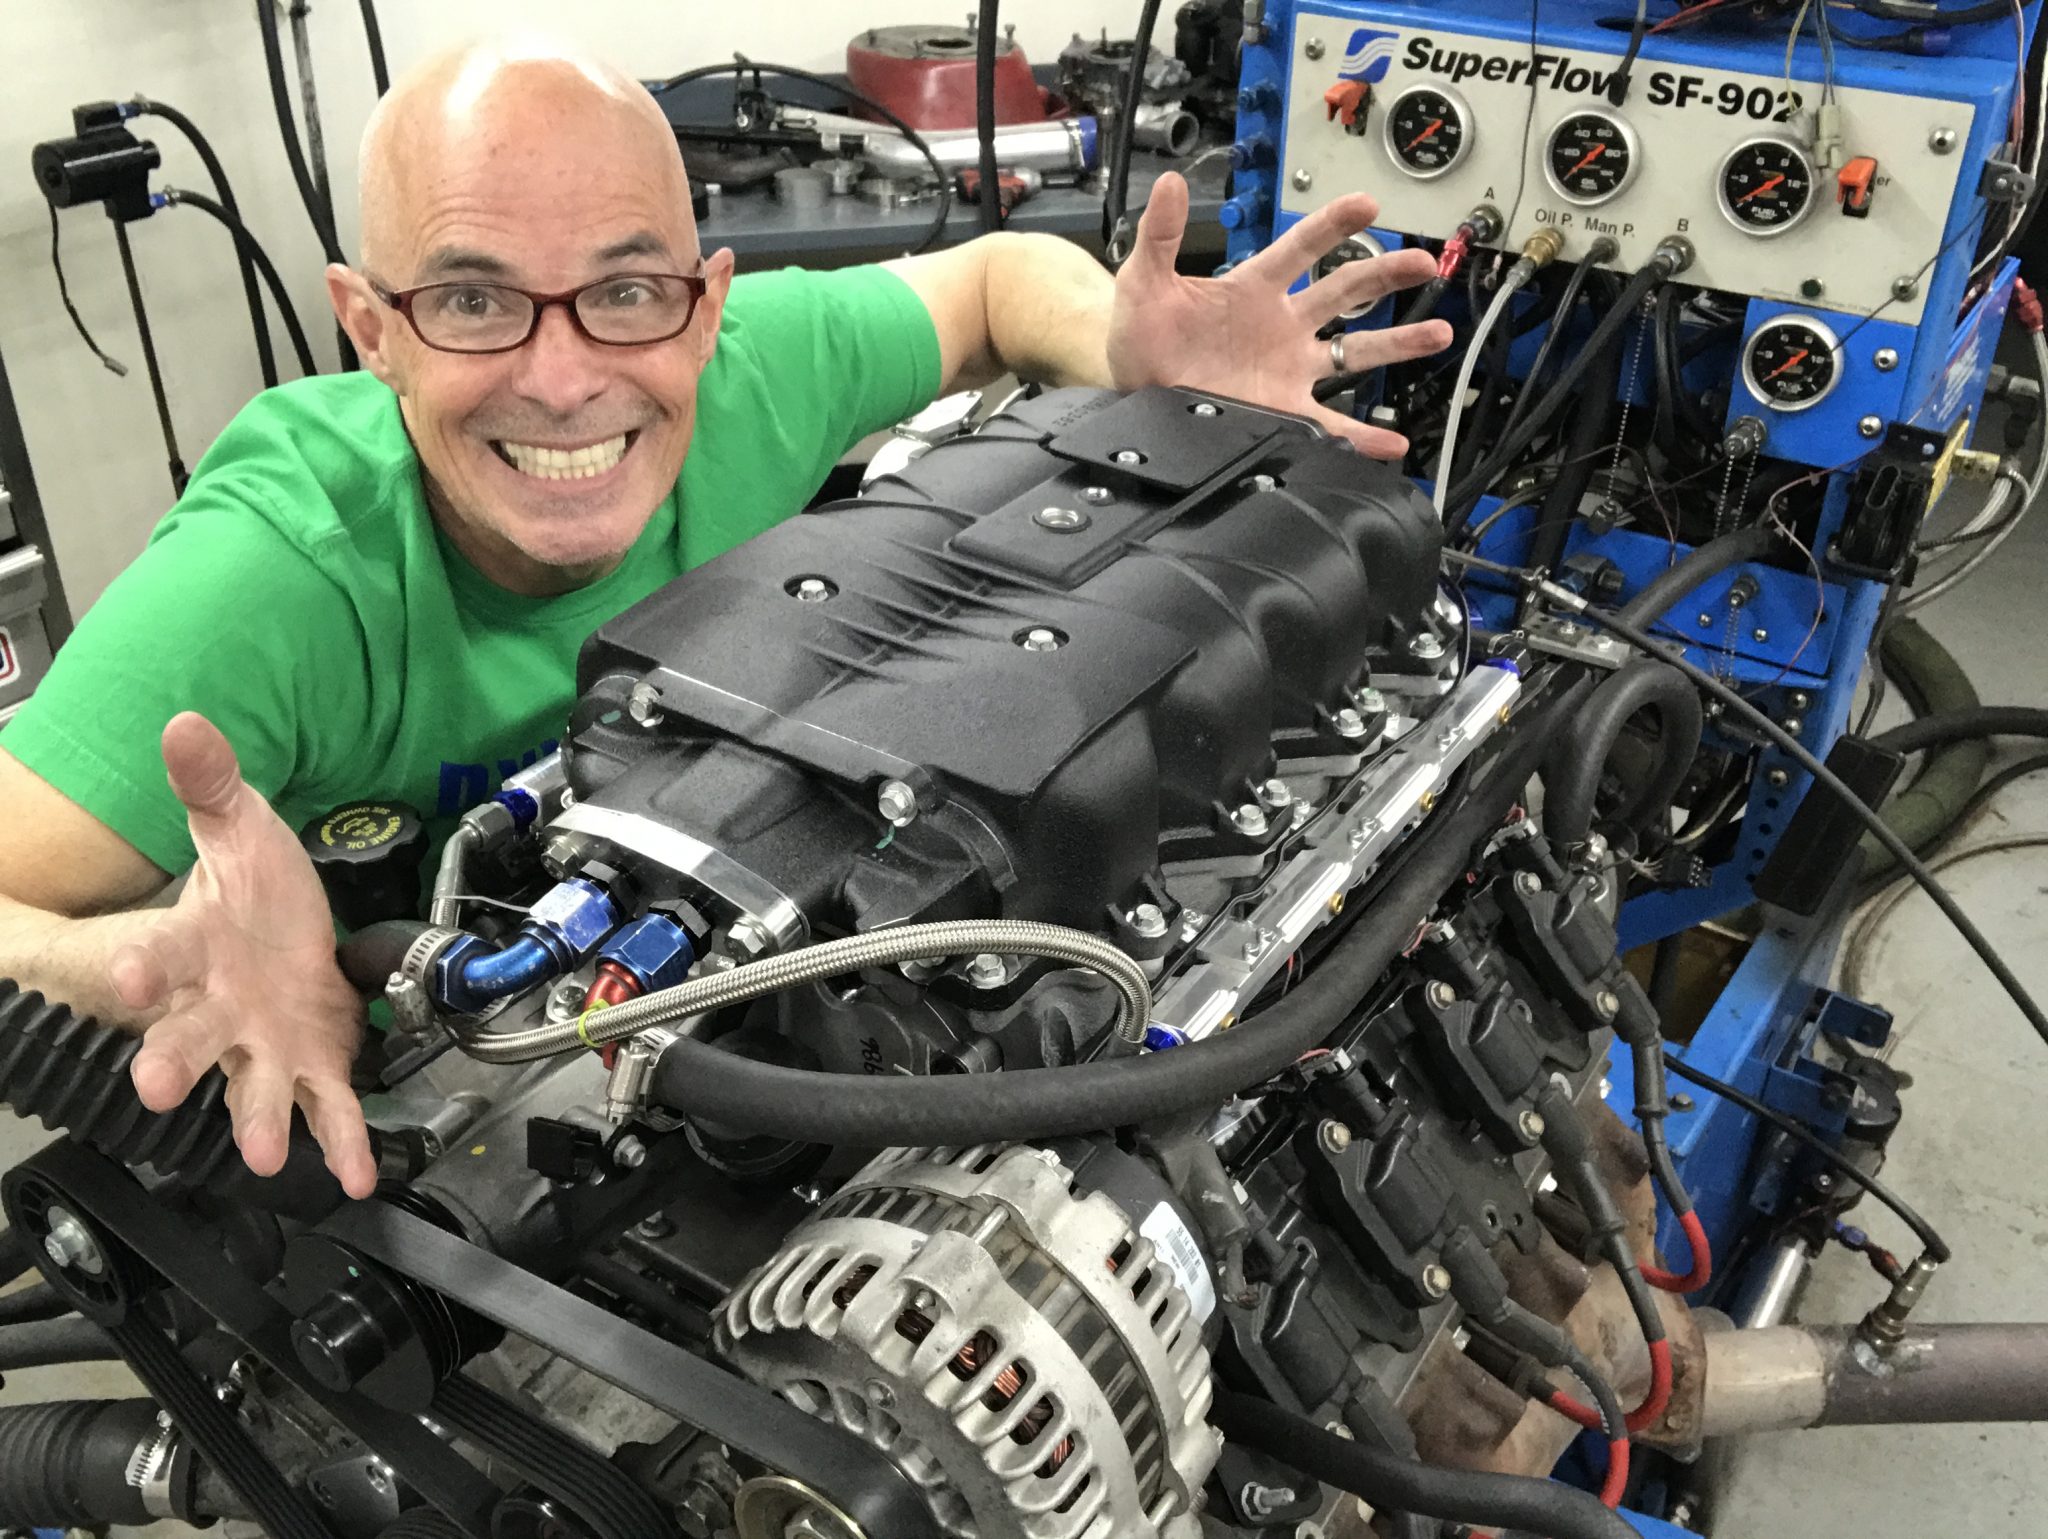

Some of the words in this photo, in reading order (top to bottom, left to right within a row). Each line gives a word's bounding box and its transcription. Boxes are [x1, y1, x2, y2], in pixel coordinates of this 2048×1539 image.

[1647, 72, 1803, 123] SF-902
[1574, 129, 1590, 138] 40
[1564, 148, 1580, 156] 20
[1788, 179, 1802, 189] 12
[1484, 186, 1495, 200] A
[1534, 207, 1557, 225] Oil
[1561, 212, 1574, 228] P.
[1584, 216, 1618, 235] Man
[1622, 223, 1636, 238] P.
[1677, 218, 1690, 232] B
[346, 840, 366, 849] OIL
